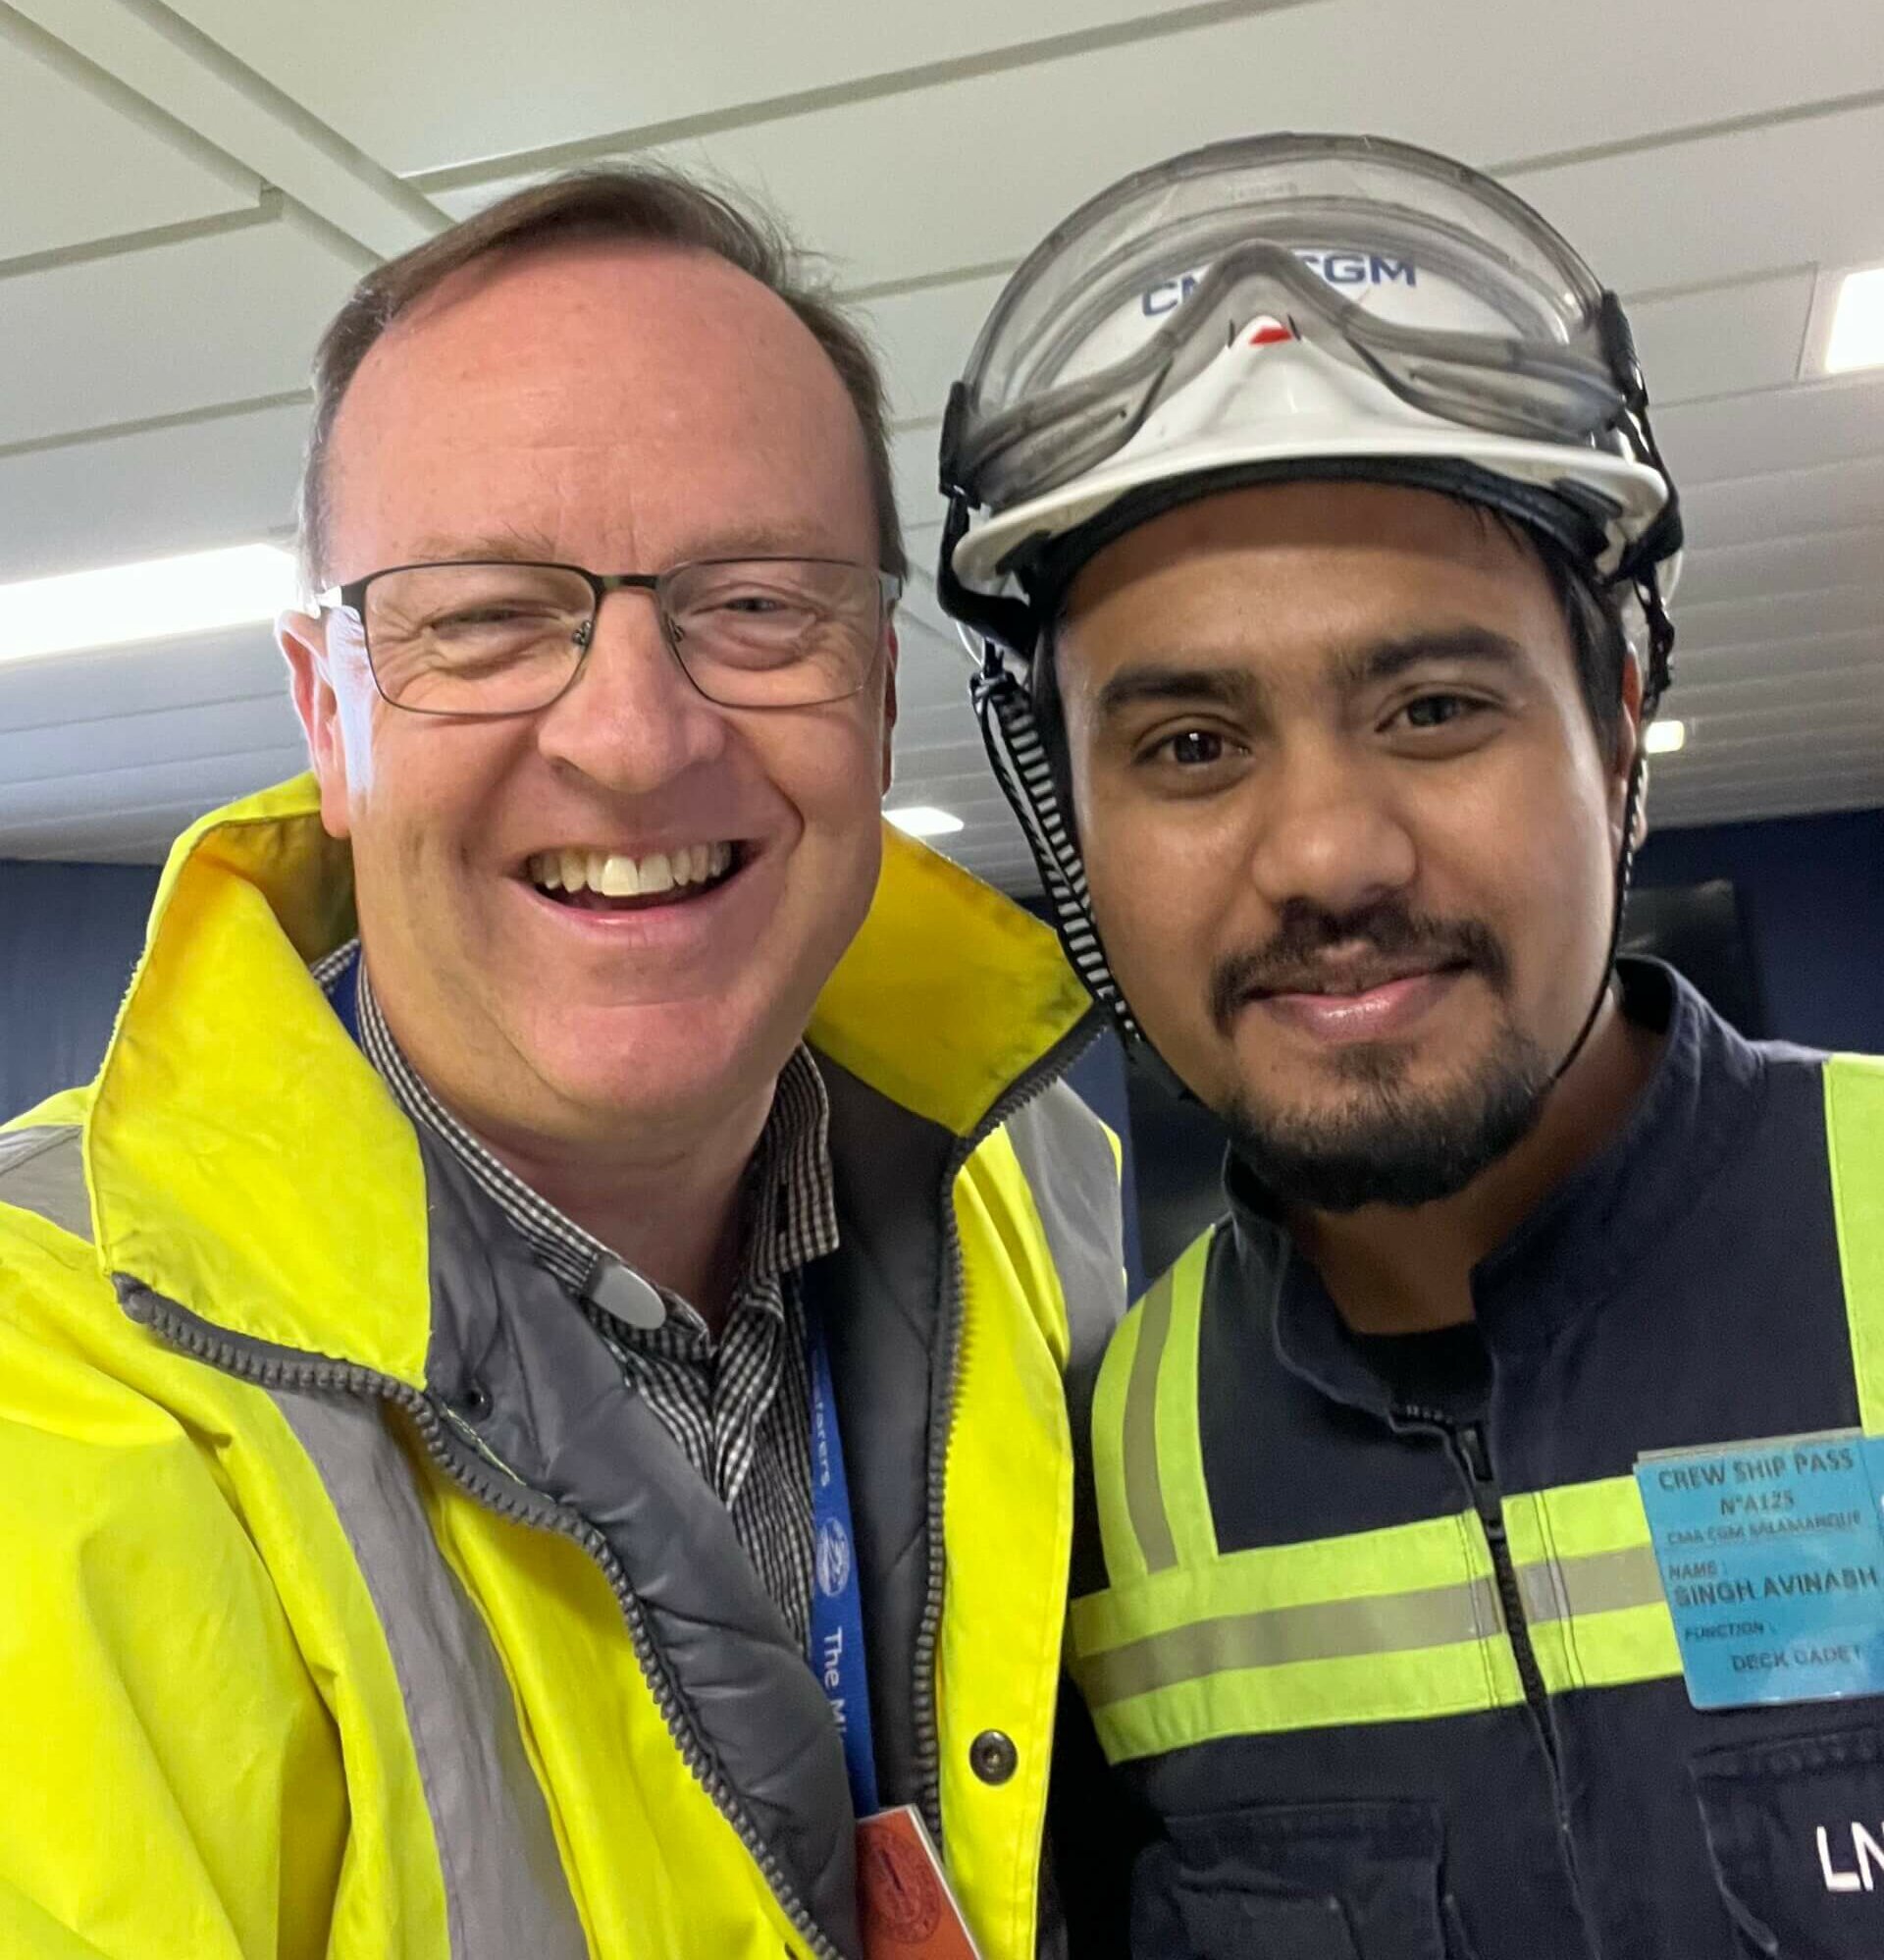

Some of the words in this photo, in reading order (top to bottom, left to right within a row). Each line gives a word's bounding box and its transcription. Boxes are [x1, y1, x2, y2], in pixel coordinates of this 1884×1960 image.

[1658, 1457, 1725, 1492] CREW
[1733, 1455, 1786, 1483] SHIP
[1794, 1448, 1855, 1475] PASS
[824, 1625, 843, 1689] The
[1731, 1649, 1788, 1672] DECK
